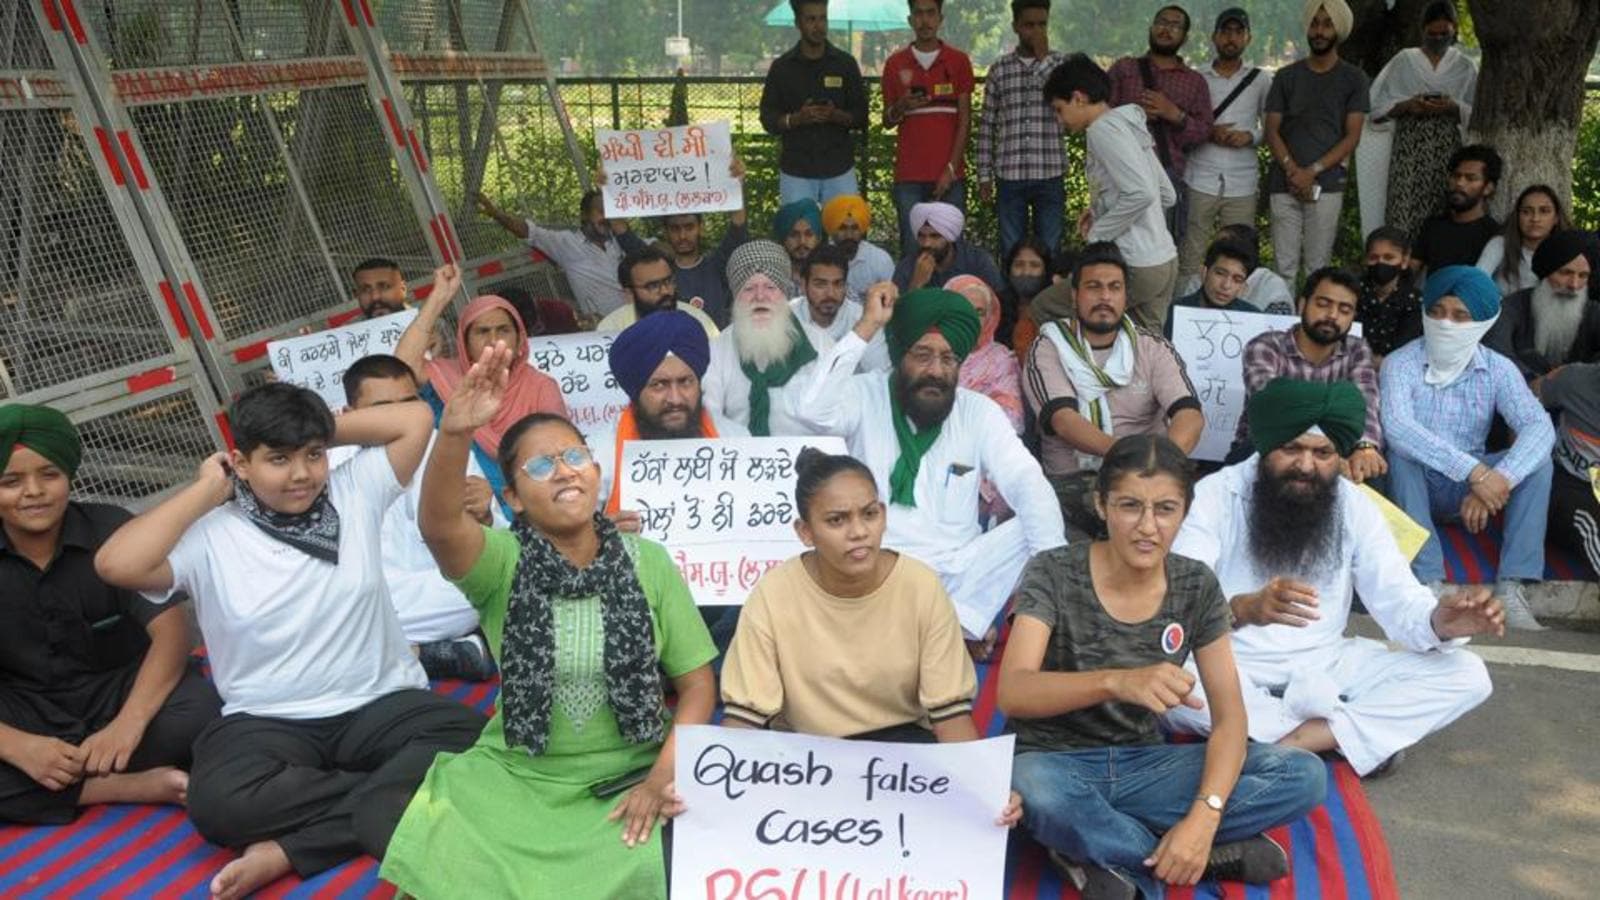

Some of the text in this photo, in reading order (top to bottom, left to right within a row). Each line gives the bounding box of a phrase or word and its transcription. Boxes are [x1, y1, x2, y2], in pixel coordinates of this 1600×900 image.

[278, 347, 293, 373] ਕੀ
[300, 334, 341, 362] ਕਰਨਗੇ
[631, 451, 668, 485] ਹੱਕਾਂ
[673, 446, 714, 487] ਲਈ
[747, 448, 793, 483] ਲੜਦੇ
[712, 491, 734, 532] ਨੀ
[747, 491, 793, 527] ਡਰਦੇ
[694, 744, 950, 801] Quash false
